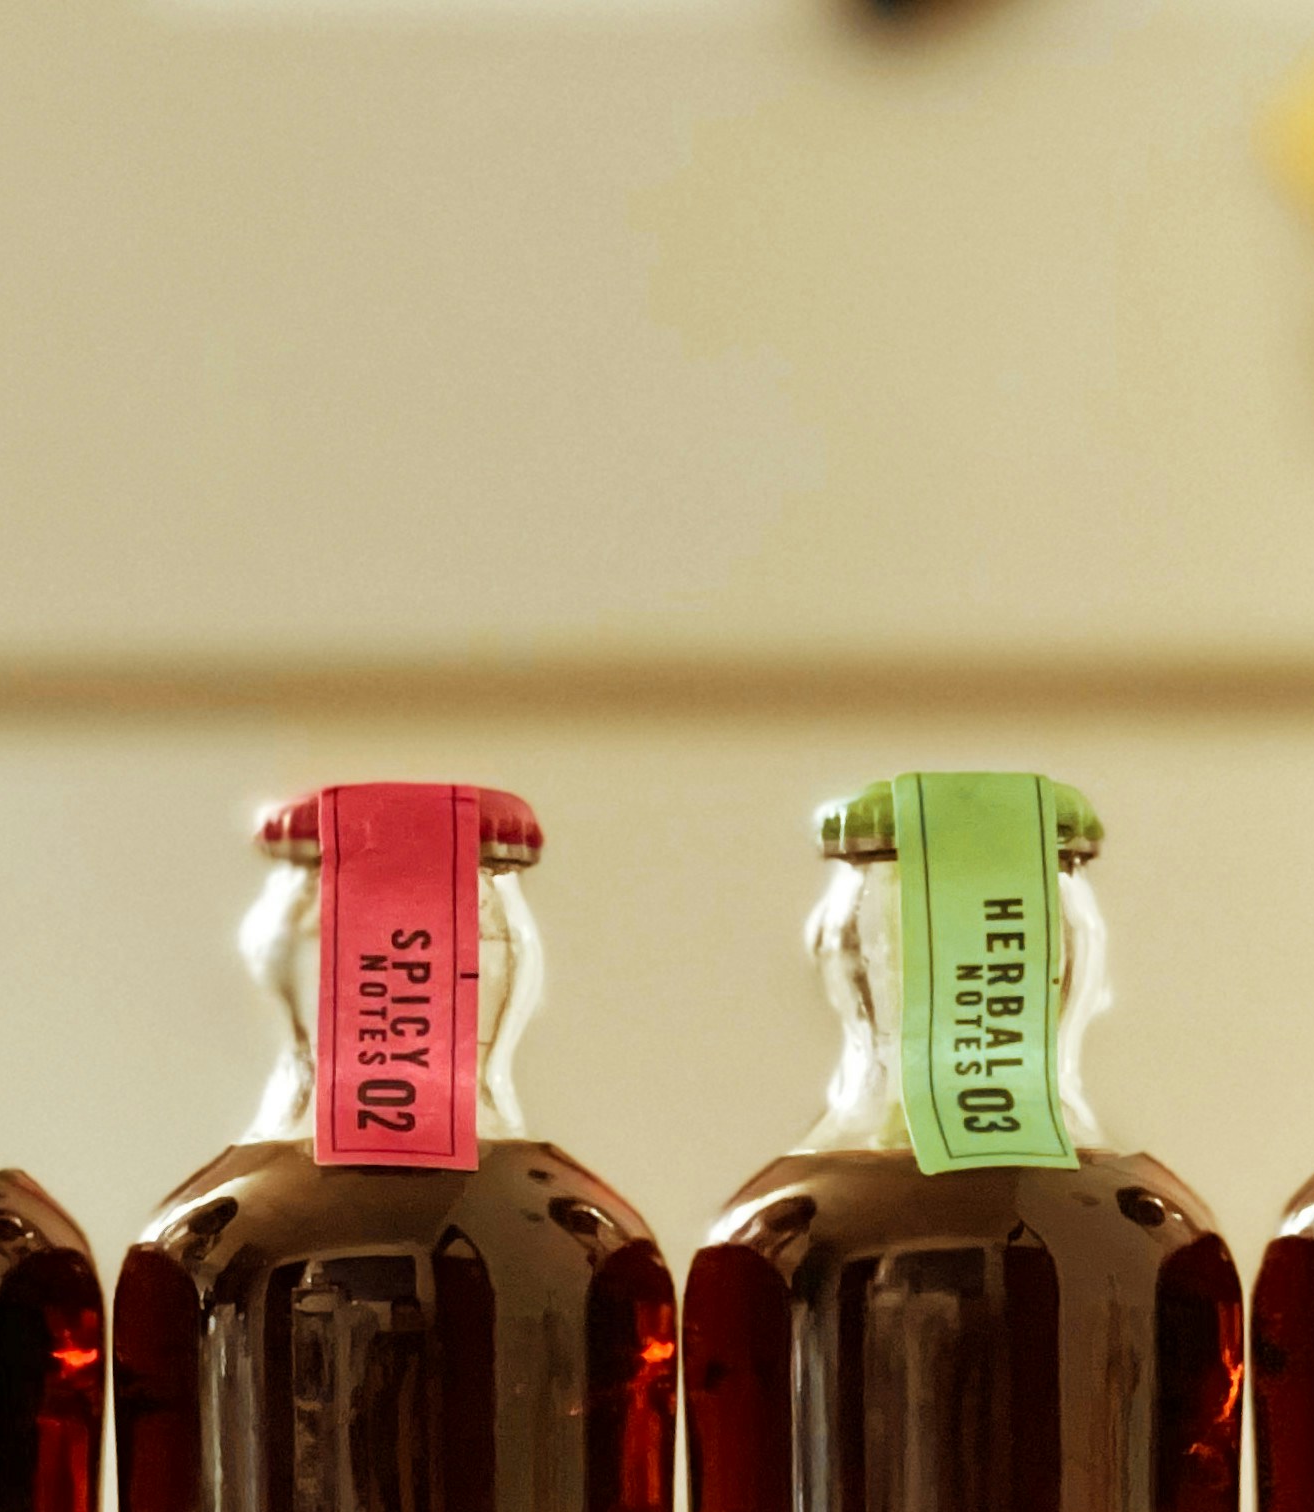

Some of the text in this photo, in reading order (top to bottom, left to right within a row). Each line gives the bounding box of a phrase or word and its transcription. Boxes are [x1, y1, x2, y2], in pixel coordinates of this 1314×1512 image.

[357, 953, 388, 1067] NOTES
[389, 928, 432, 1069] SPICY
[954, 964, 984, 1077] NOTES
[983, 898, 1026, 1077] HERBAL
[356, 1078, 417, 1133] 02
[956, 1087, 1021, 1135] 03
